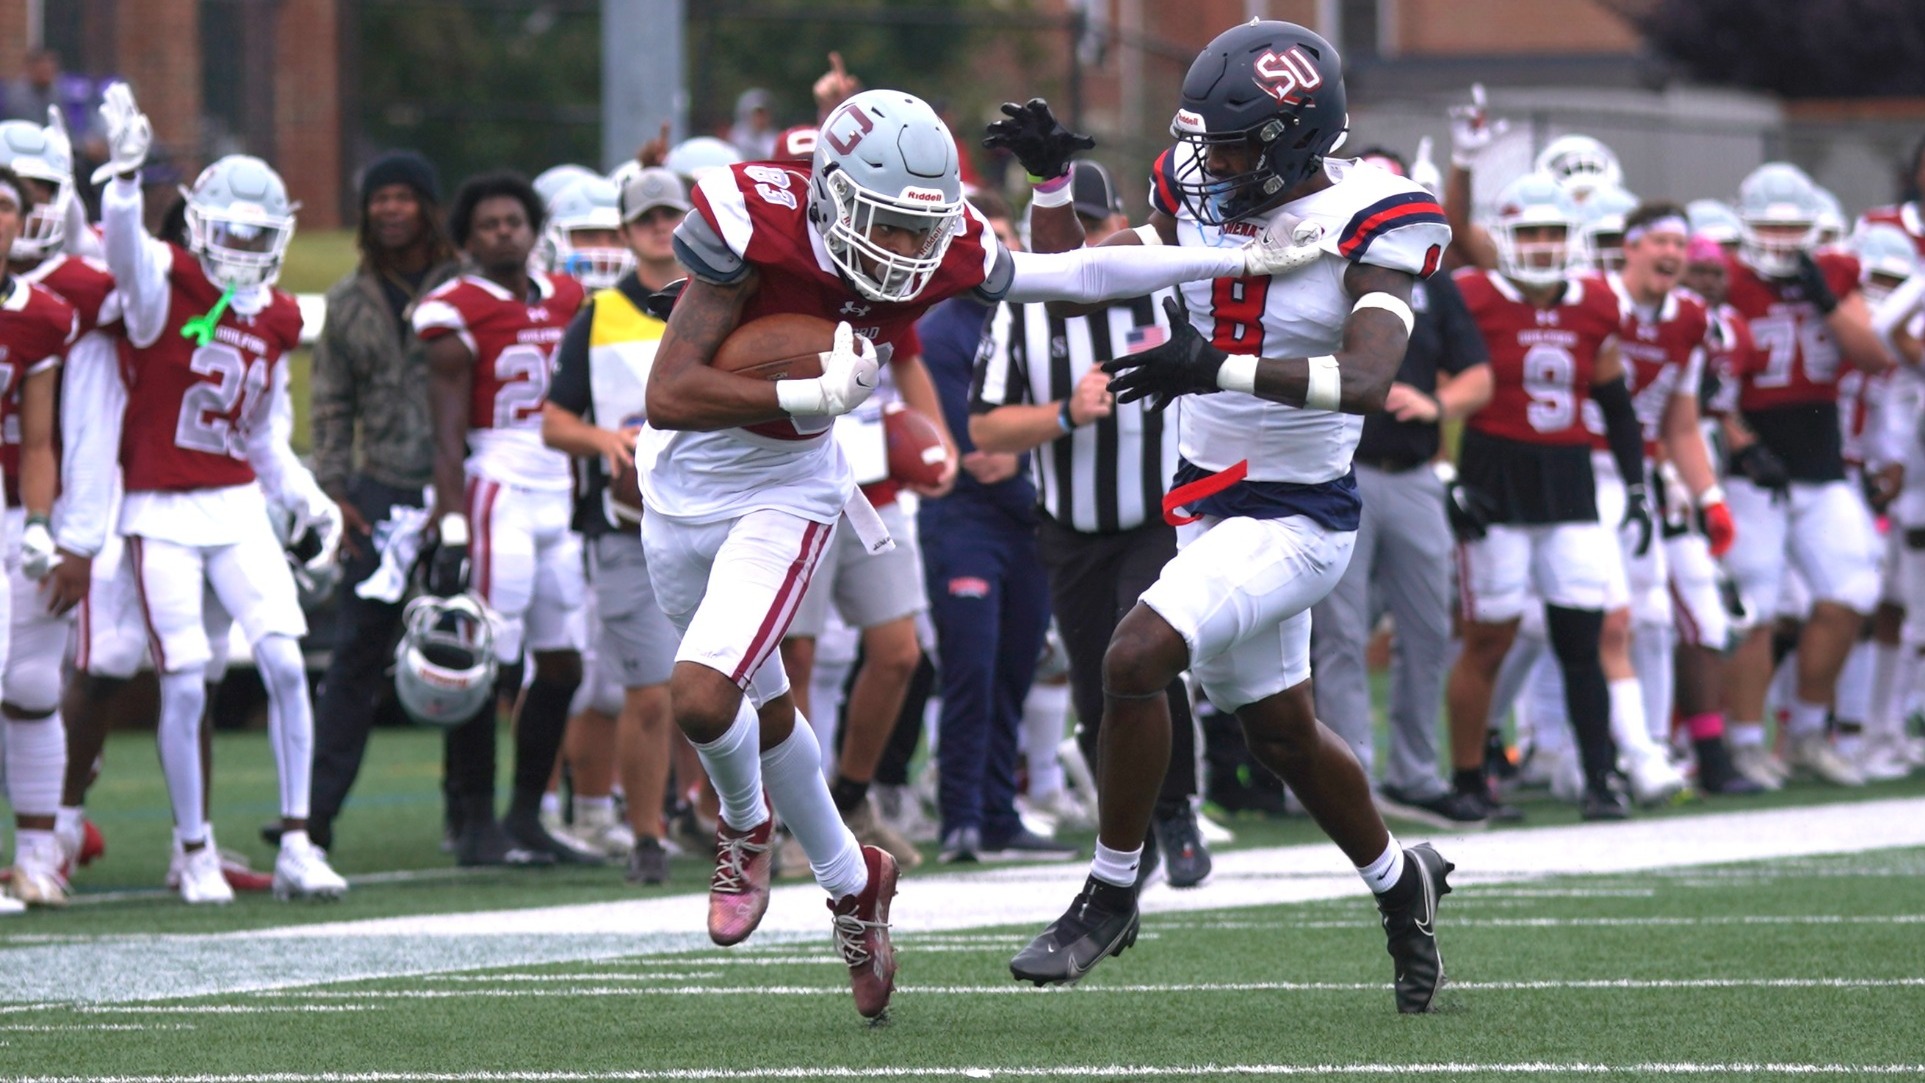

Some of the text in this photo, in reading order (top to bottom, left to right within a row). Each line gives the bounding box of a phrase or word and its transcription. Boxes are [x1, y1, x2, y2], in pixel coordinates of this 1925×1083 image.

[1254, 47, 1322, 104] SU
[743, 165, 797, 210] 83
[908, 191, 942, 201] Riddell
[920, 226, 943, 256] Riddell
[1210, 274, 1272, 357] 8
[1523, 343, 1575, 434] 9
